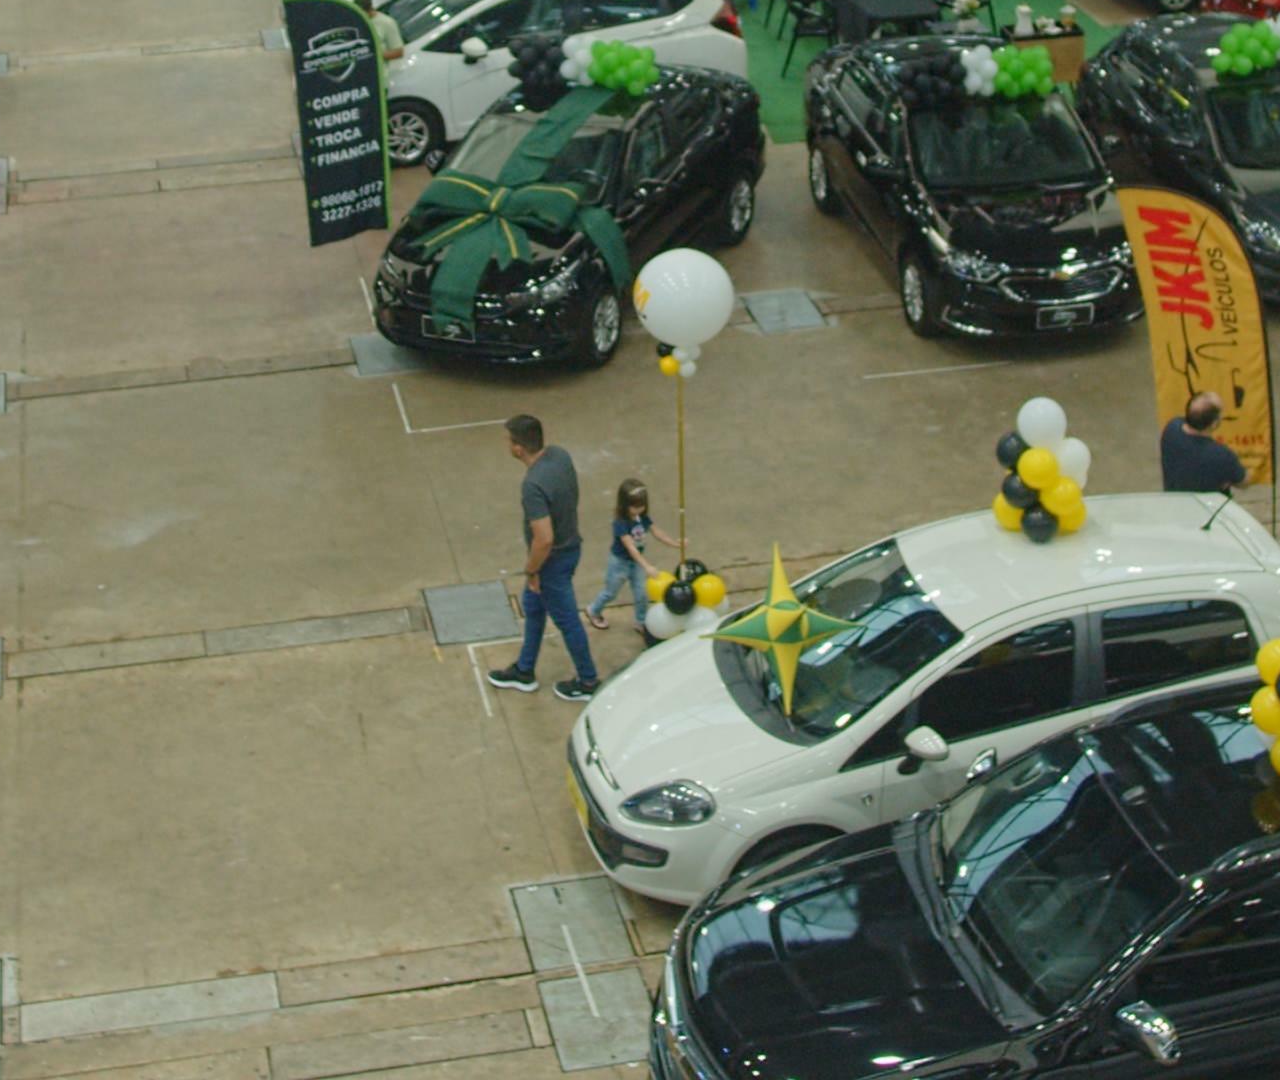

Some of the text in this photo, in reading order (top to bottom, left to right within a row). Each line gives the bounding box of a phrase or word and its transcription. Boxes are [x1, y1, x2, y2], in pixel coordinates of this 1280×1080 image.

[312, 87, 370, 109] COMPRA
[314, 108, 360, 128] VENDE
[315, 126, 362, 147] TROCA
[317, 139, 380, 167] FINANCIA
[1137, 206, 1214, 330] JKIM
[1207, 247, 1238, 336] VEÍCULOS
